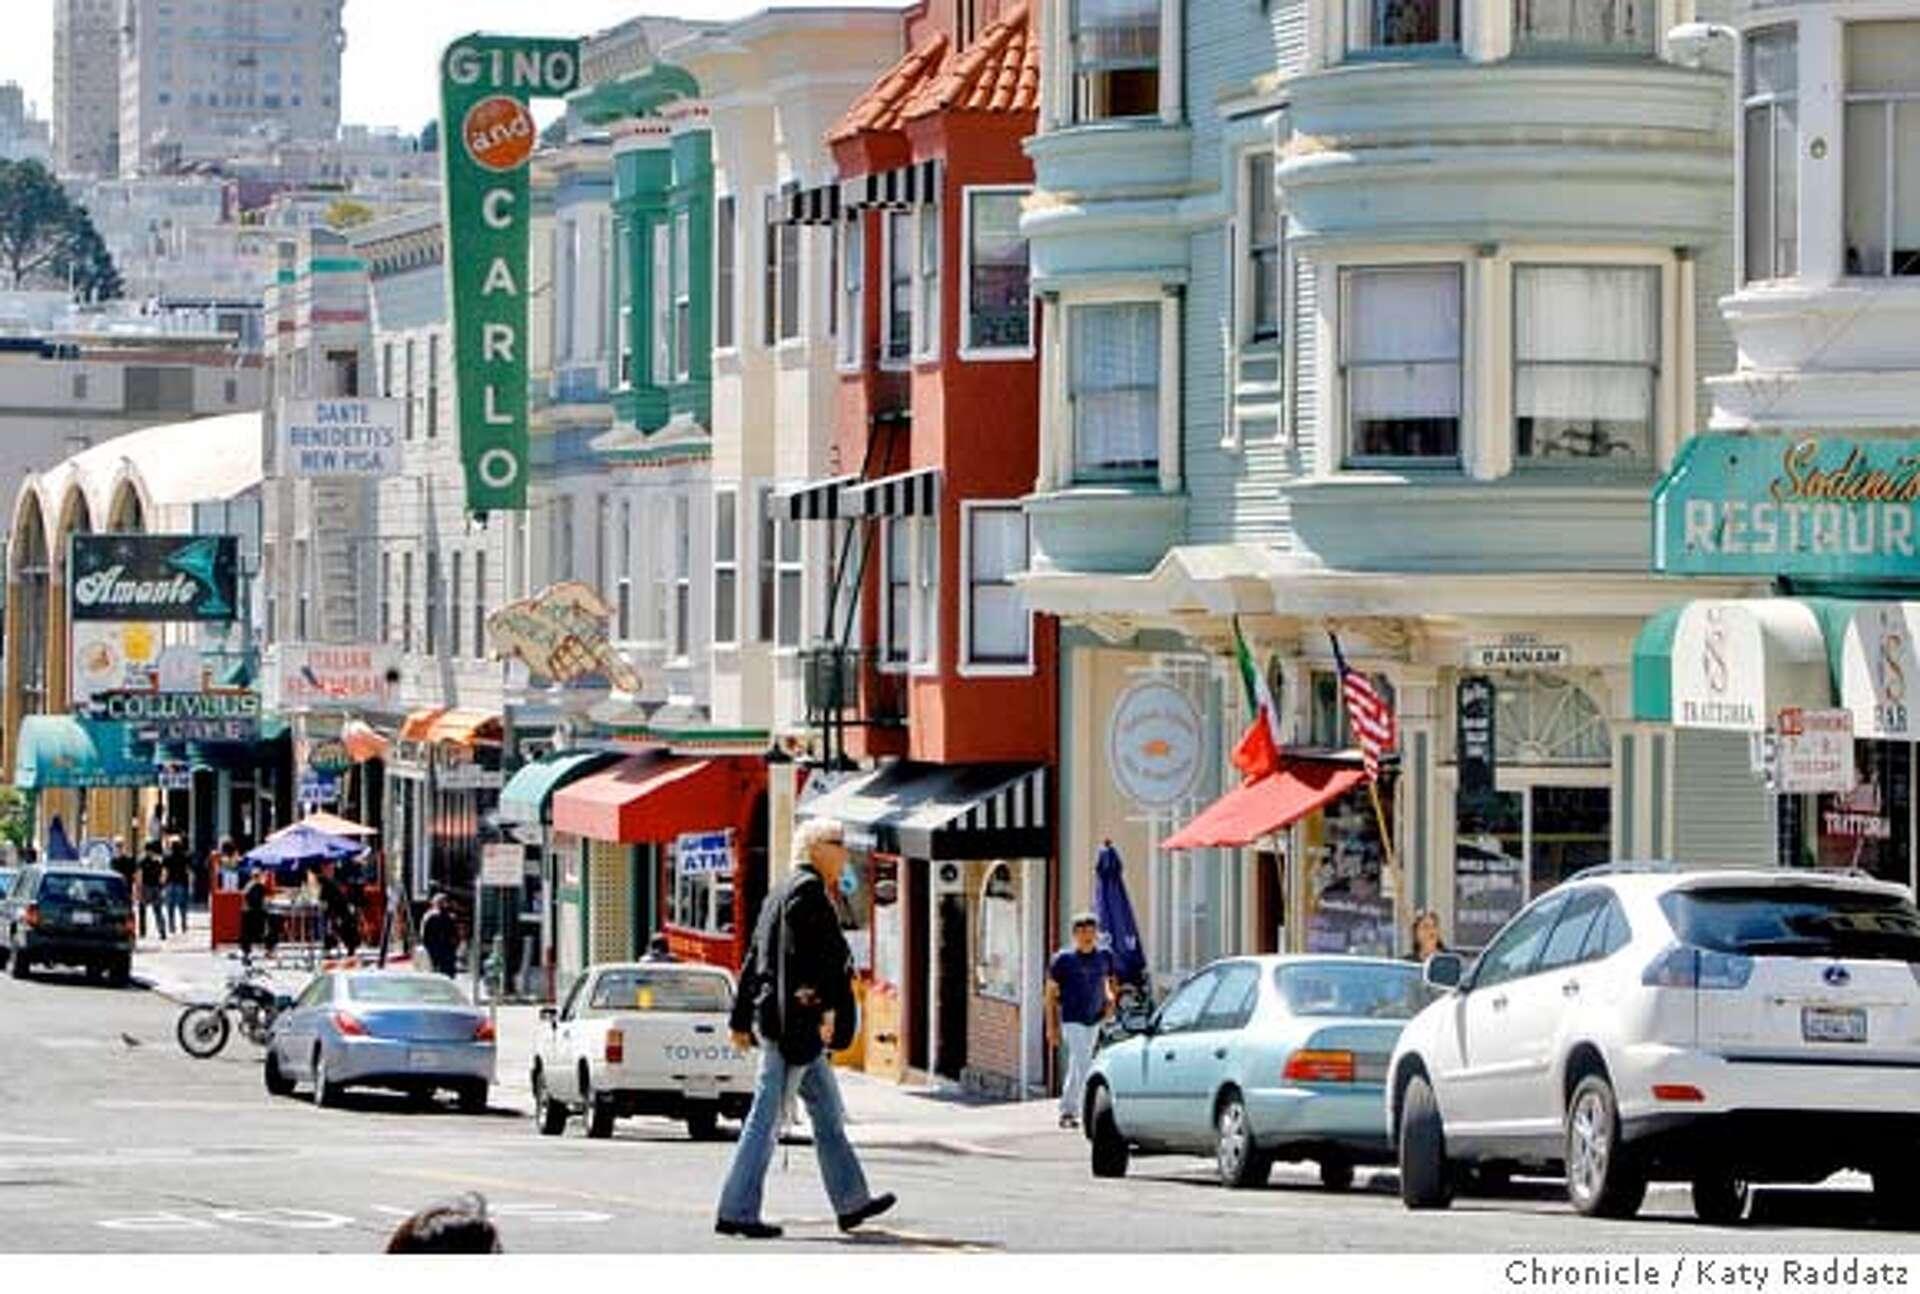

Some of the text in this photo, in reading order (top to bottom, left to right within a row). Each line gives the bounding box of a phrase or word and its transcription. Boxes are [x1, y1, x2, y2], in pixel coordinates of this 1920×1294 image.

[449, 45, 575, 91] GINO
[472, 112, 531, 151] and
[479, 187, 518, 488] CARLO
[317, 402, 369, 424] DANTE
[301, 450, 382, 471] NEW PISA
[1684, 498, 1916, 556] RESTAUR
[75, 565, 199, 605] Amante
[1482, 650, 1561, 664] BANNAM
[685, 852, 729, 870] ATM
